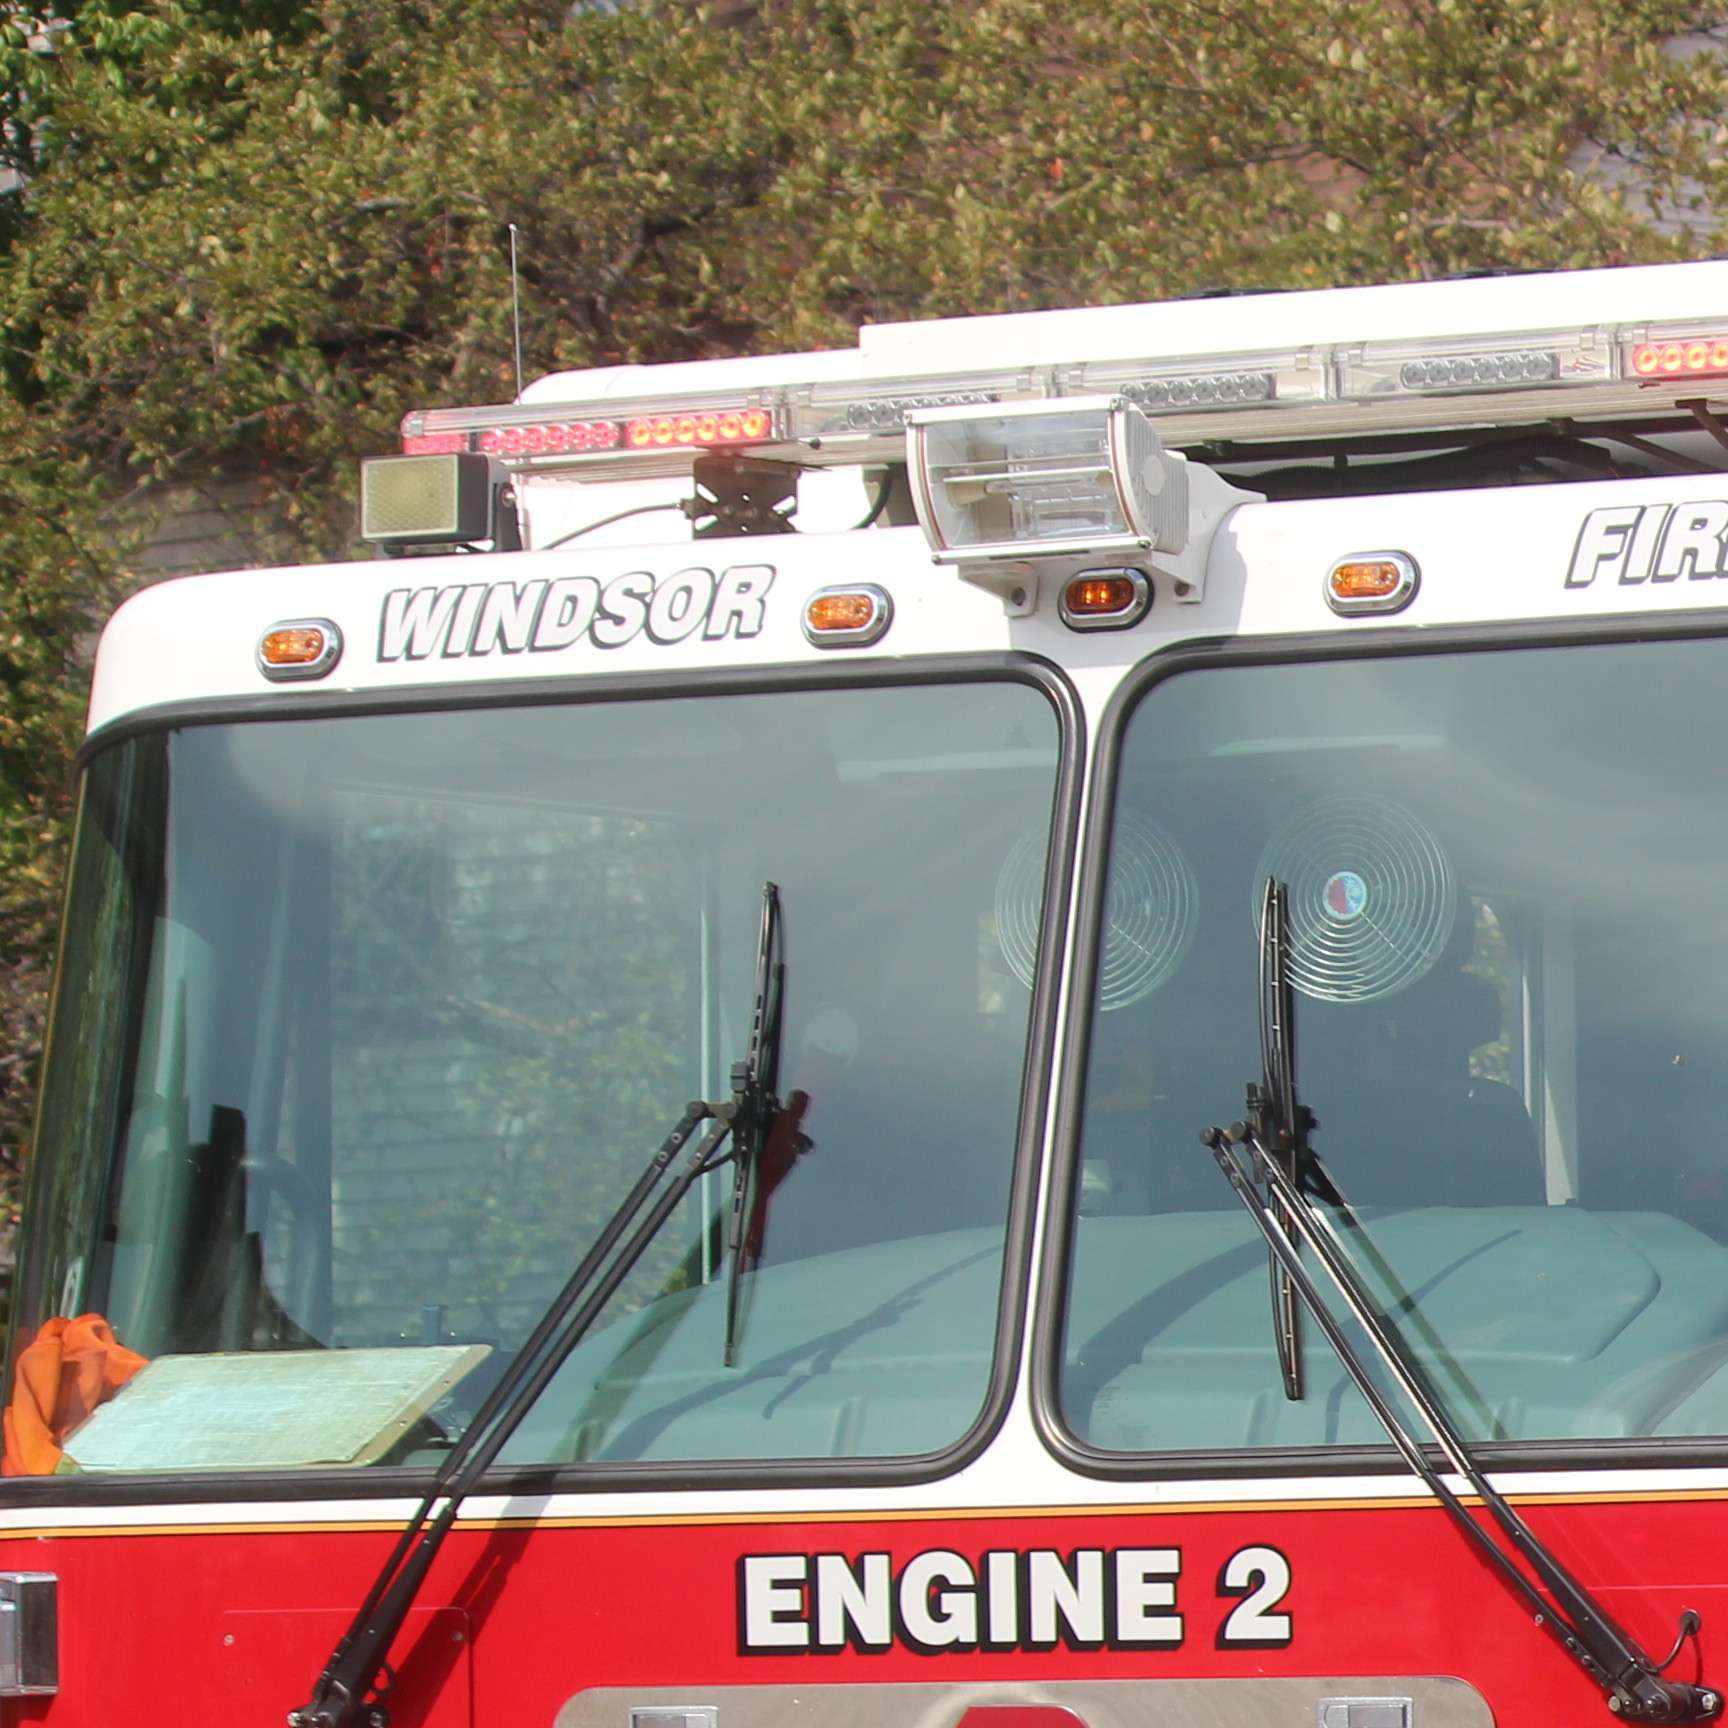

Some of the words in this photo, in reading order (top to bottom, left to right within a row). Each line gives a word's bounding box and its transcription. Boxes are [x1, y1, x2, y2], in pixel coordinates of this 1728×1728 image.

[376, 563, 776, 663] WINDSOR
[737, 1547, 1184, 1655] ENGINE
[1216, 1545, 1292, 1651] 2
